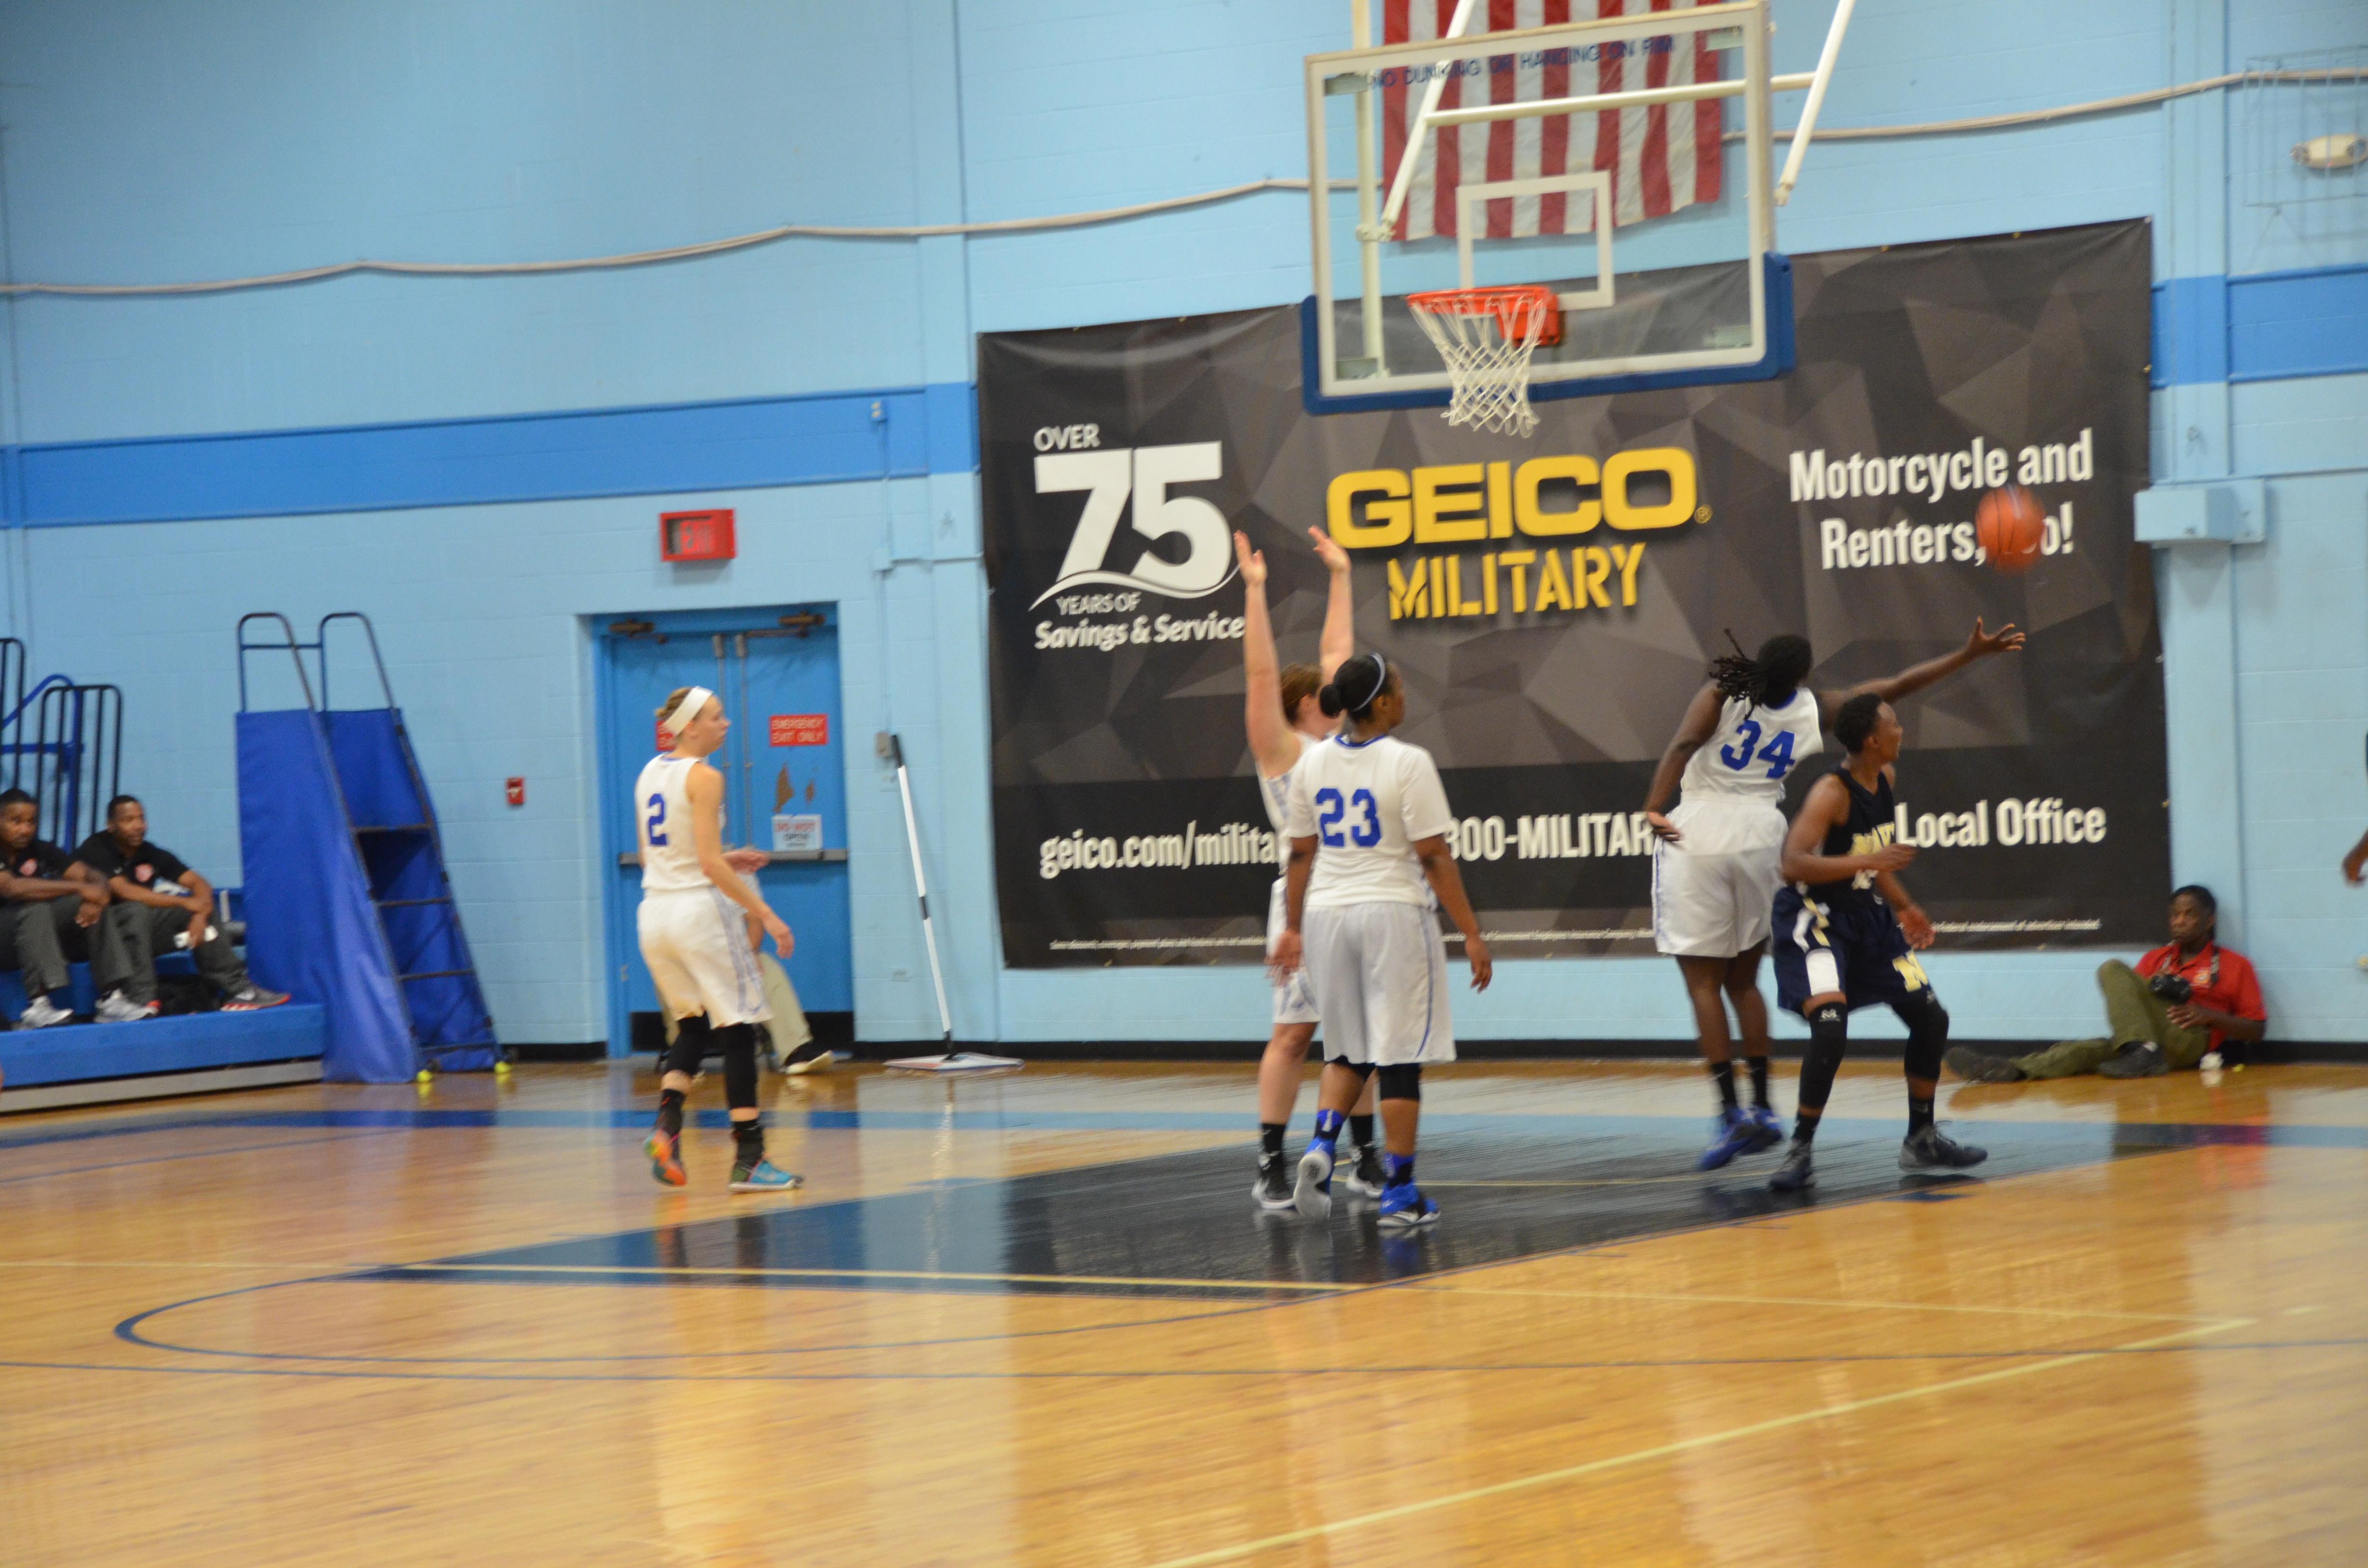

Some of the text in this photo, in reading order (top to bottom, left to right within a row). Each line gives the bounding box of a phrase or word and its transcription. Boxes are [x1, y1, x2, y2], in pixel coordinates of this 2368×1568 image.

[1520, 44, 1600, 69] HANGING
[1607, 42, 1634, 59] ON
[1034, 423, 1101, 452] OVER
[1789, 427, 2094, 504] Motorcycle and
[1034, 440, 1232, 591] 75
[1821, 517, 1986, 570] Renters,
[1056, 591, 1141, 615] YEARS OF
[1387, 541, 1646, 620] MILITARY
[1035, 610, 1246, 651] Savings & Service
[1720, 719, 1796, 779] 34
[648, 793, 667, 846] 2
[1040, 820, 1279, 880] geico.com/milita
[1894, 799, 1989, 848] Local
[1996, 796, 2107, 846] Office
[1315, 788, 1381, 847] 23
